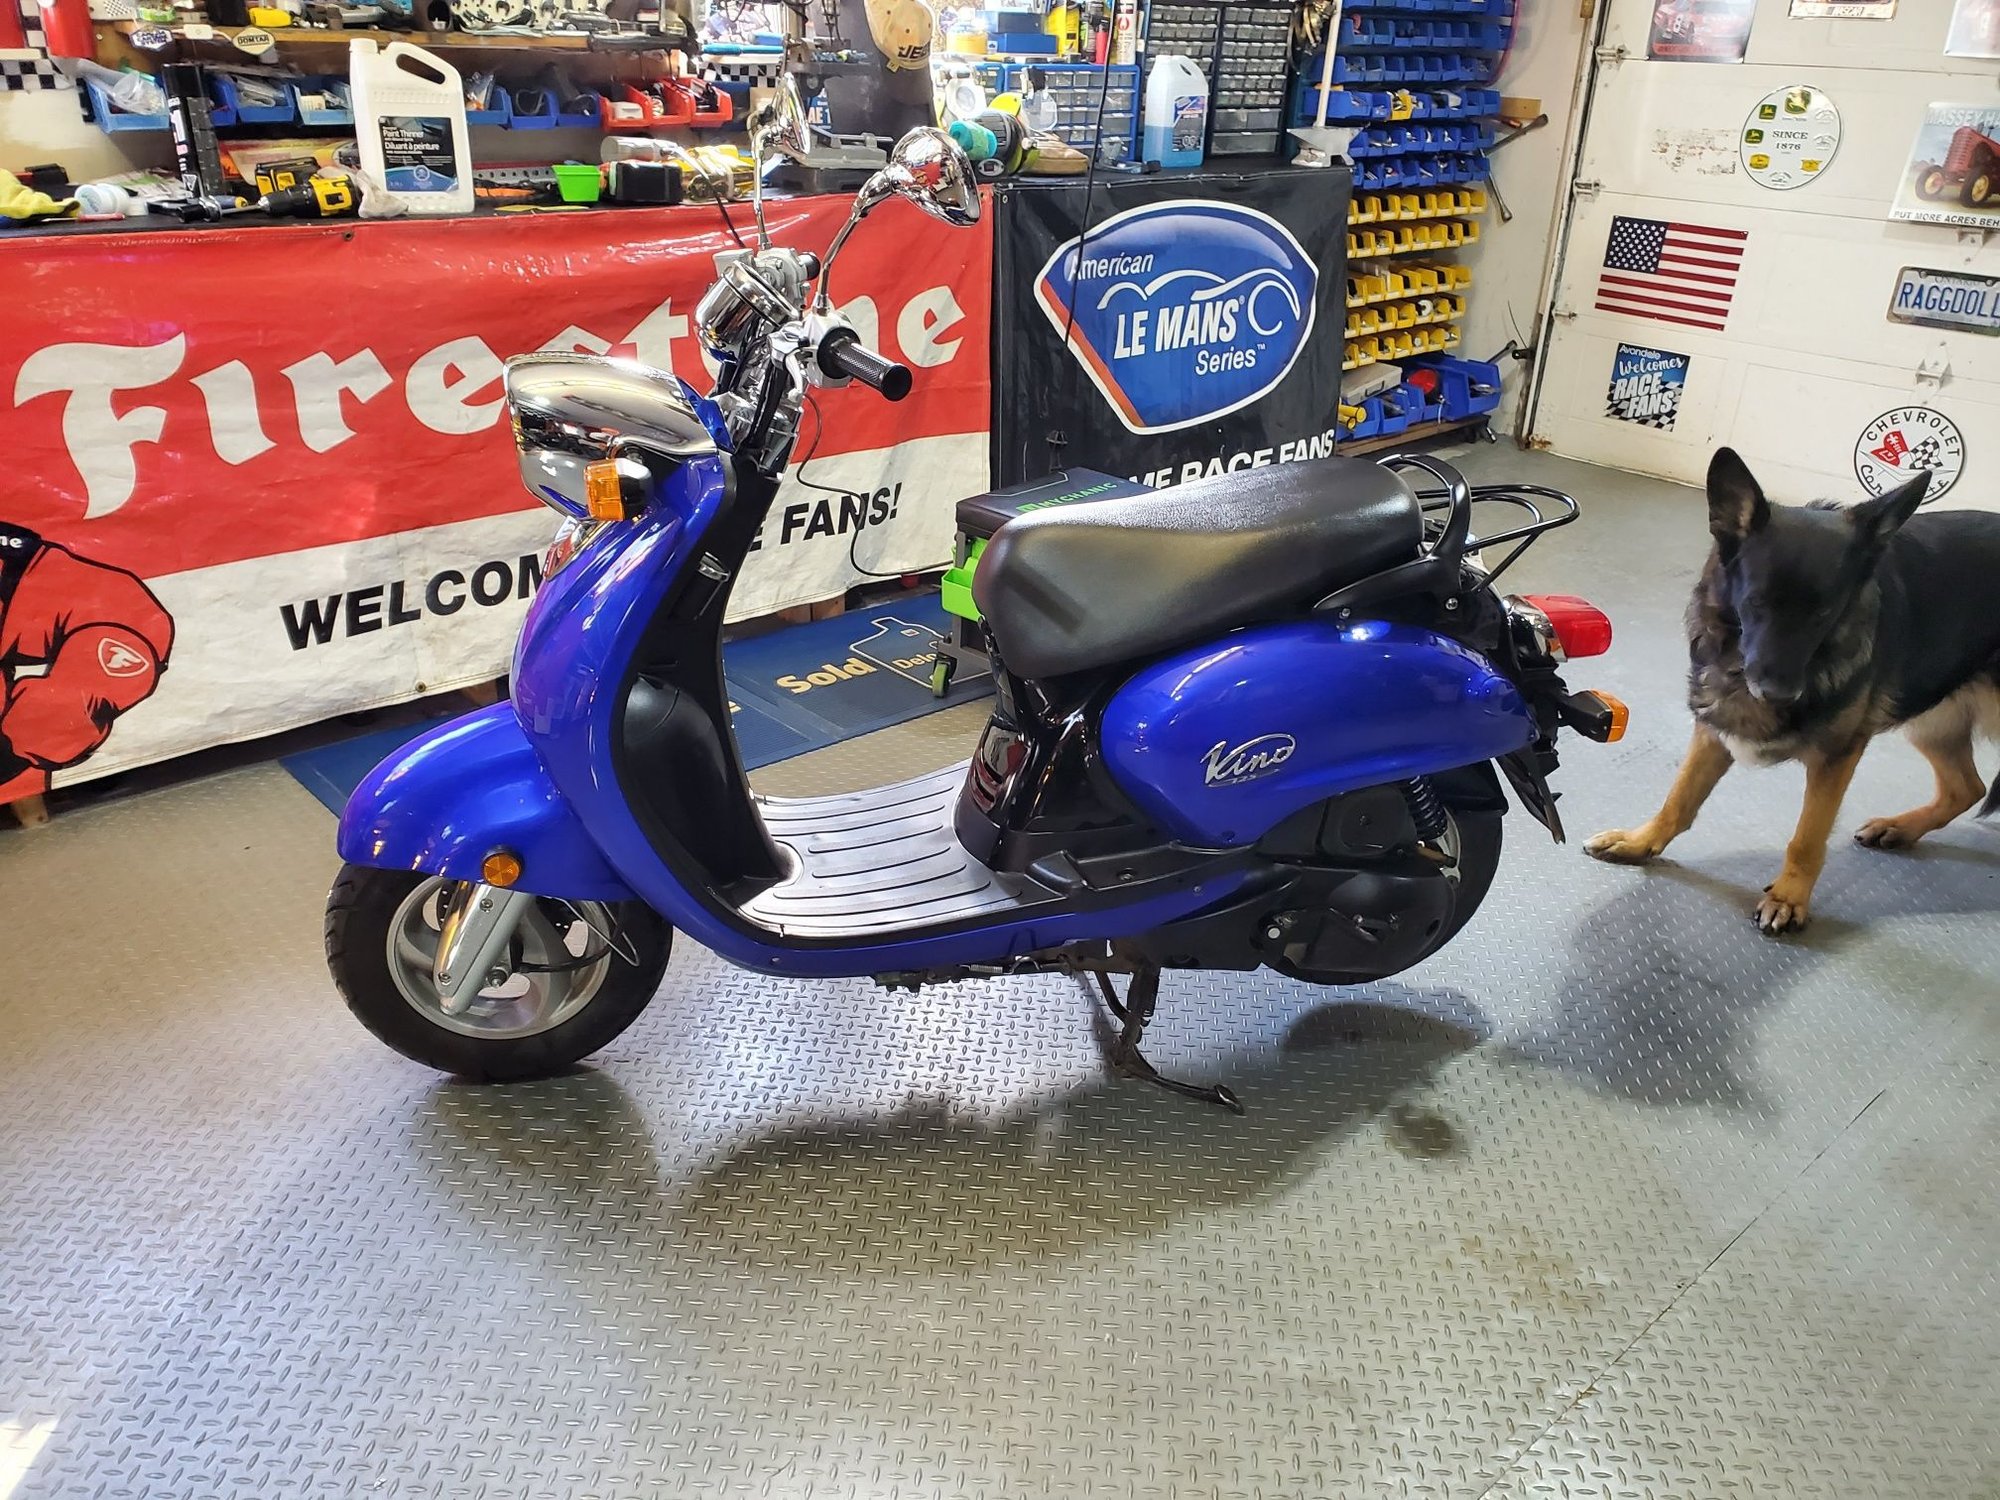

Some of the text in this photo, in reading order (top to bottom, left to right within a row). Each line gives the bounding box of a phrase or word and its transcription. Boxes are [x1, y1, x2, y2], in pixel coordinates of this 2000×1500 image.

[383, 129, 424, 138] Paint Thinner
[413, 142, 440, 151] peinture
[1772, 130, 1809, 140] SINCE
[1776, 142, 1801, 151] 1876
[1893, 210, 1912, 219] PUT
[1914, 212, 1942, 222] MORE
[1944, 215, 1977, 226] ACRES
[1067, 252, 1154, 282] American
[1897, 282, 2000, 320] RAGGDOLL
[1113, 309, 1149, 360] LE
[1619, 344, 1661, 360] Avondale
[1619, 357, 1685, 377] Welcomes
[1613, 371, 1663, 401] RACE
[1627, 391, 1675, 419] FANS
[1866, 410, 1960, 457] CHEVROLET
[1180, 447, 1274, 484] RACE
[1279, 428, 1335, 464] FANS
[780, 482, 903, 546] FANS!
[279, 552, 546, 652] WELCO
[775, 657, 878, 695] Sold
